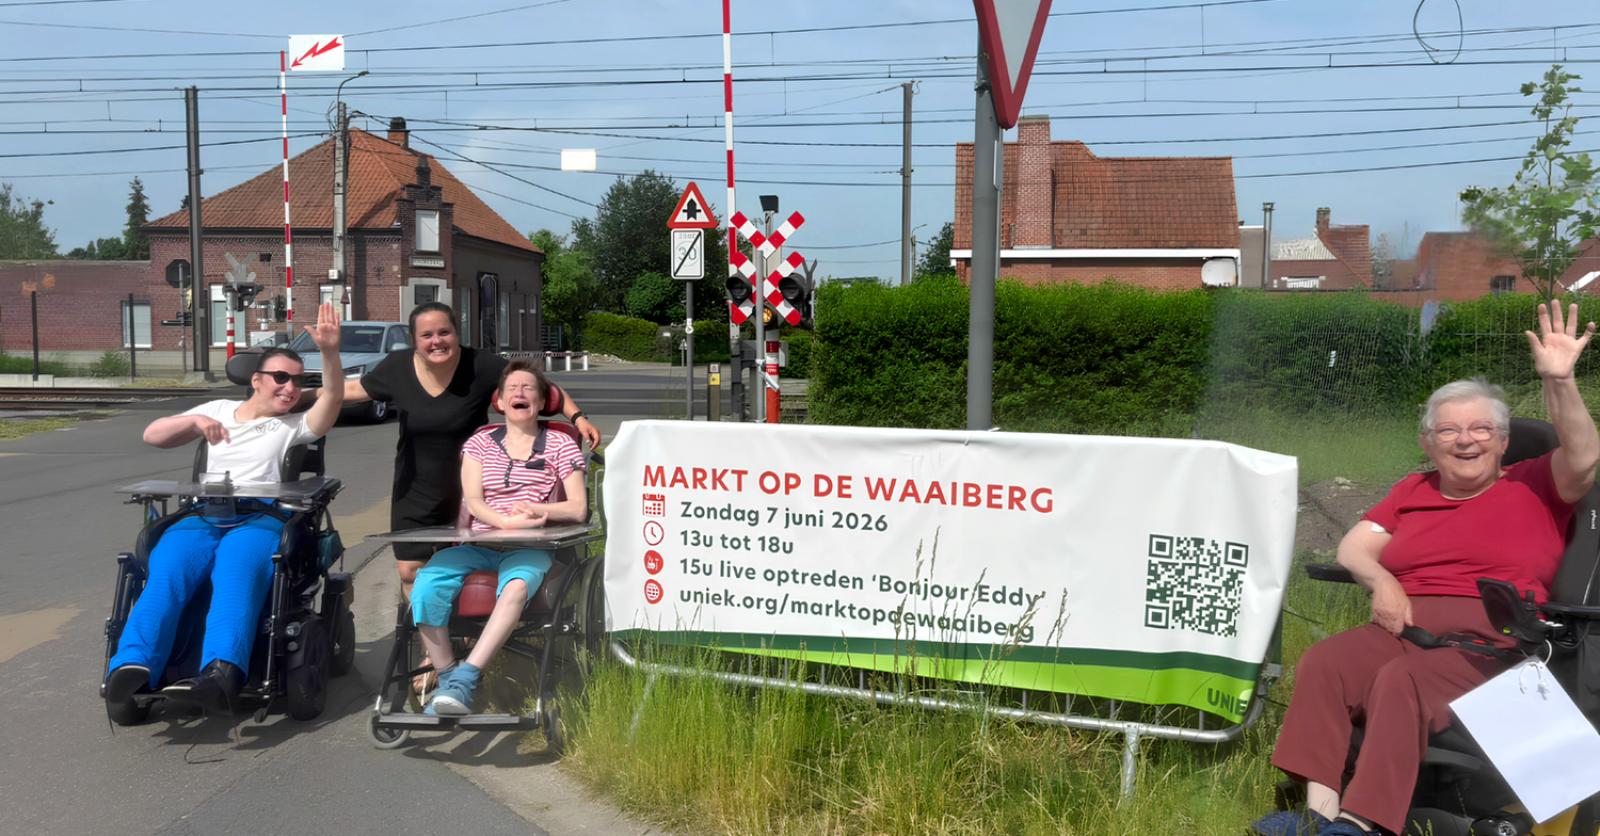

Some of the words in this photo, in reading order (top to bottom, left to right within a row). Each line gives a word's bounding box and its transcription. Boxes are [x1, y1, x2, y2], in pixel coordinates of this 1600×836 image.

[643, 465, 748, 492] MARKT
[758, 470, 802, 495] OP
[813, 473, 853, 498] DE
[864, 477, 1054, 514] WAAIBERG
[680, 501, 760, 526] Zondag
[766, 507, 779, 523] 7
[784, 507, 824, 529] juni
[831, 511, 888, 532] 2026
[680, 530, 713, 548] 13u
[720, 533, 751, 551] tot
[757, 536, 794, 554] 18u
[680, 558, 713, 576] 15u
[719, 560, 757, 580] live
[763, 567, 864, 590] optreden
[680, 587, 1035, 643] uniek.org/marktopdewaaiberg
